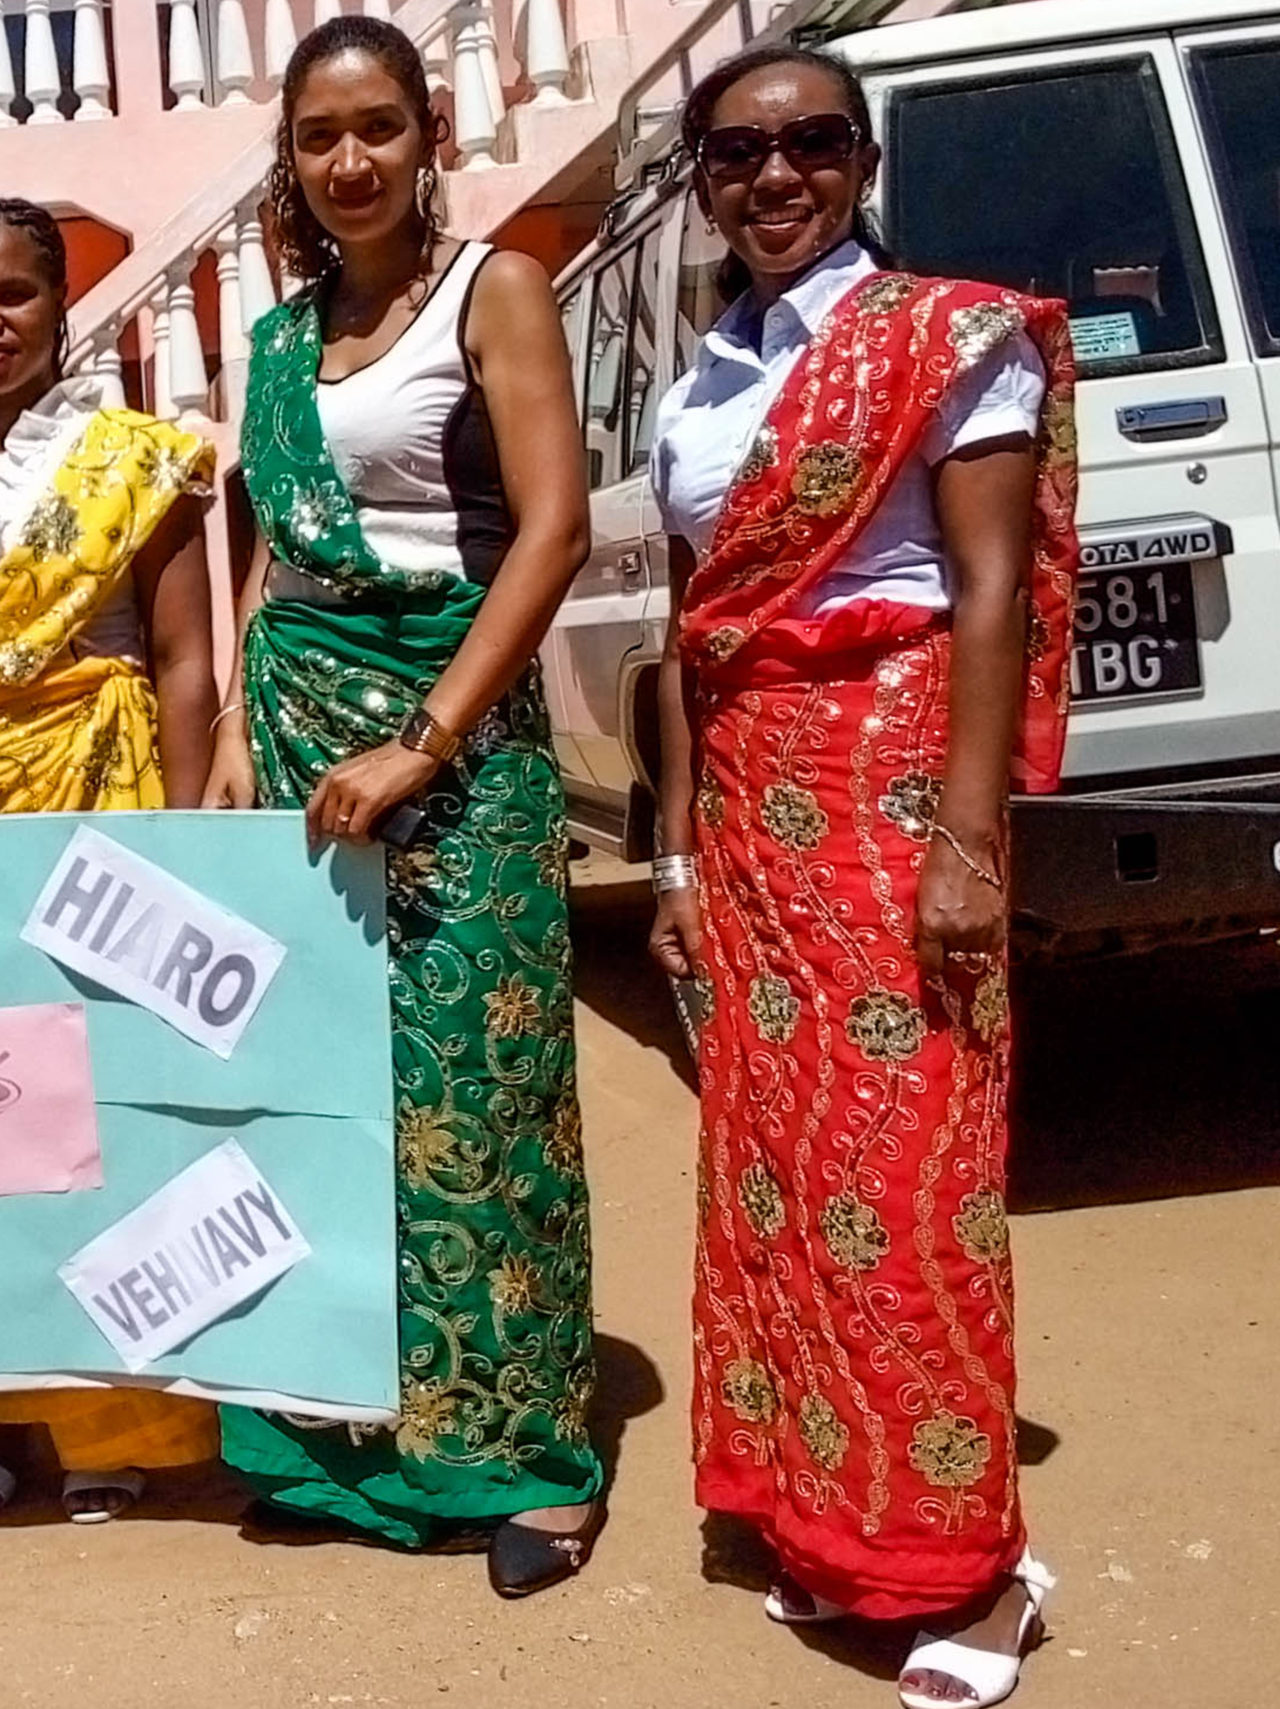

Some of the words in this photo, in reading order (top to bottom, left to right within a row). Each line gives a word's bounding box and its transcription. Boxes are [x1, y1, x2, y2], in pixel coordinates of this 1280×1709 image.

[1143, 532, 1211, 559] 4WD
[41, 855, 257, 1028] HIARO
[91, 1180, 293, 1343] VEHIVAVY
